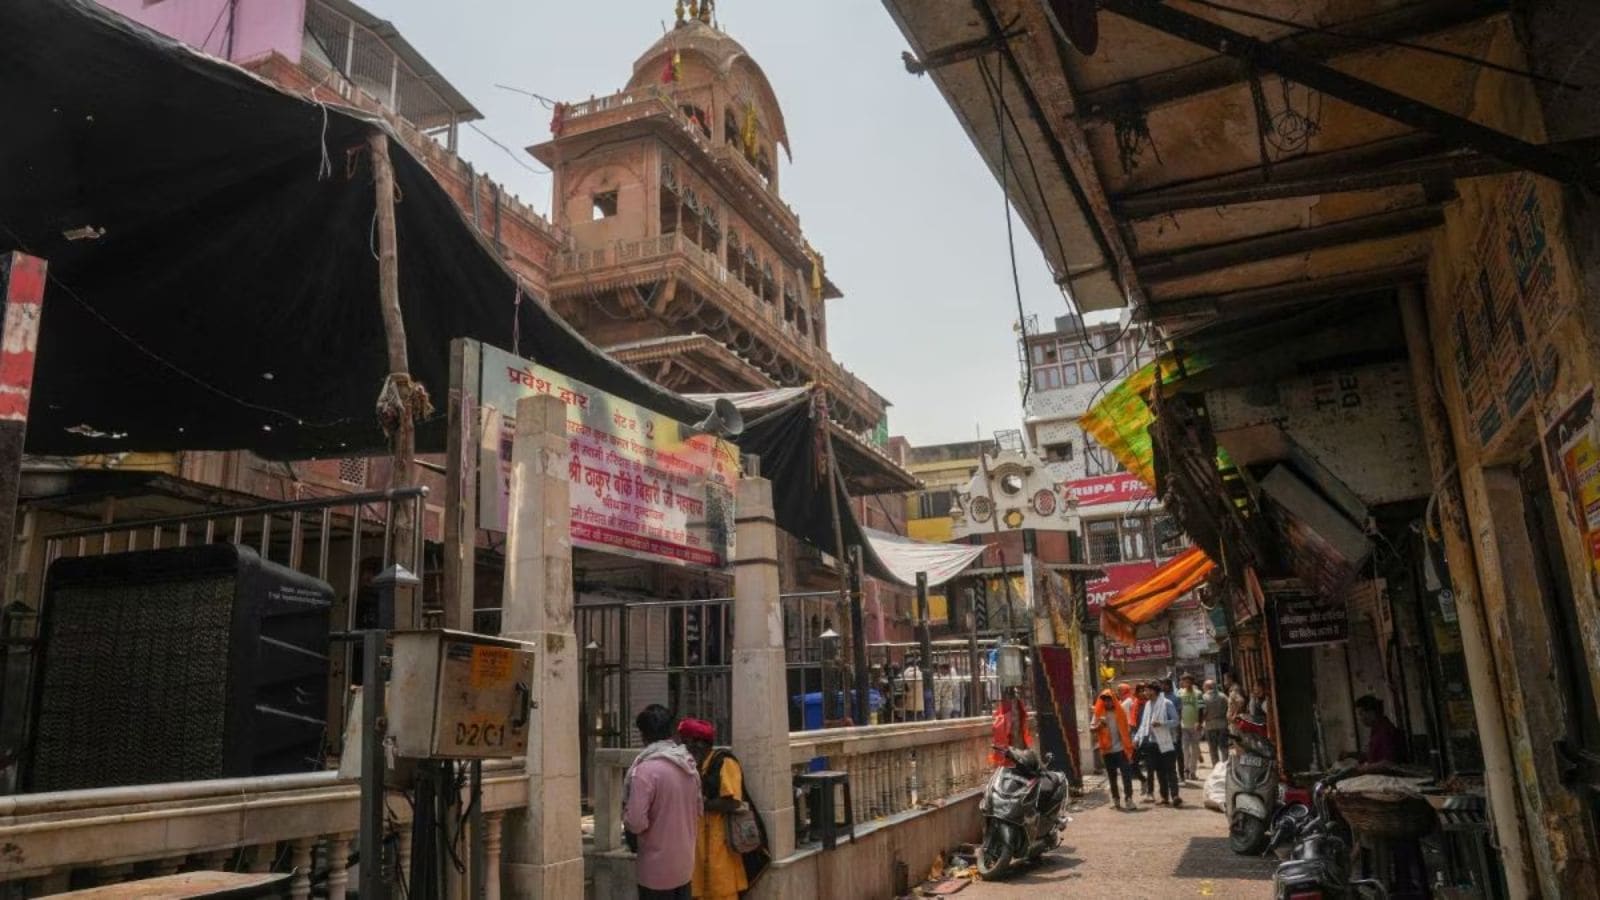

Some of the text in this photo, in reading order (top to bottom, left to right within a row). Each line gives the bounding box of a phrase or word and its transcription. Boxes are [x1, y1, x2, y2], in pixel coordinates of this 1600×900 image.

[507, 366, 552, 393] प्रवेश
[569, 454, 581, 484] श्री
[584, 466, 611, 498] ठाकुर
[635, 475, 659, 505] बिहारी
[1072, 483, 1115, 496] RUPA
